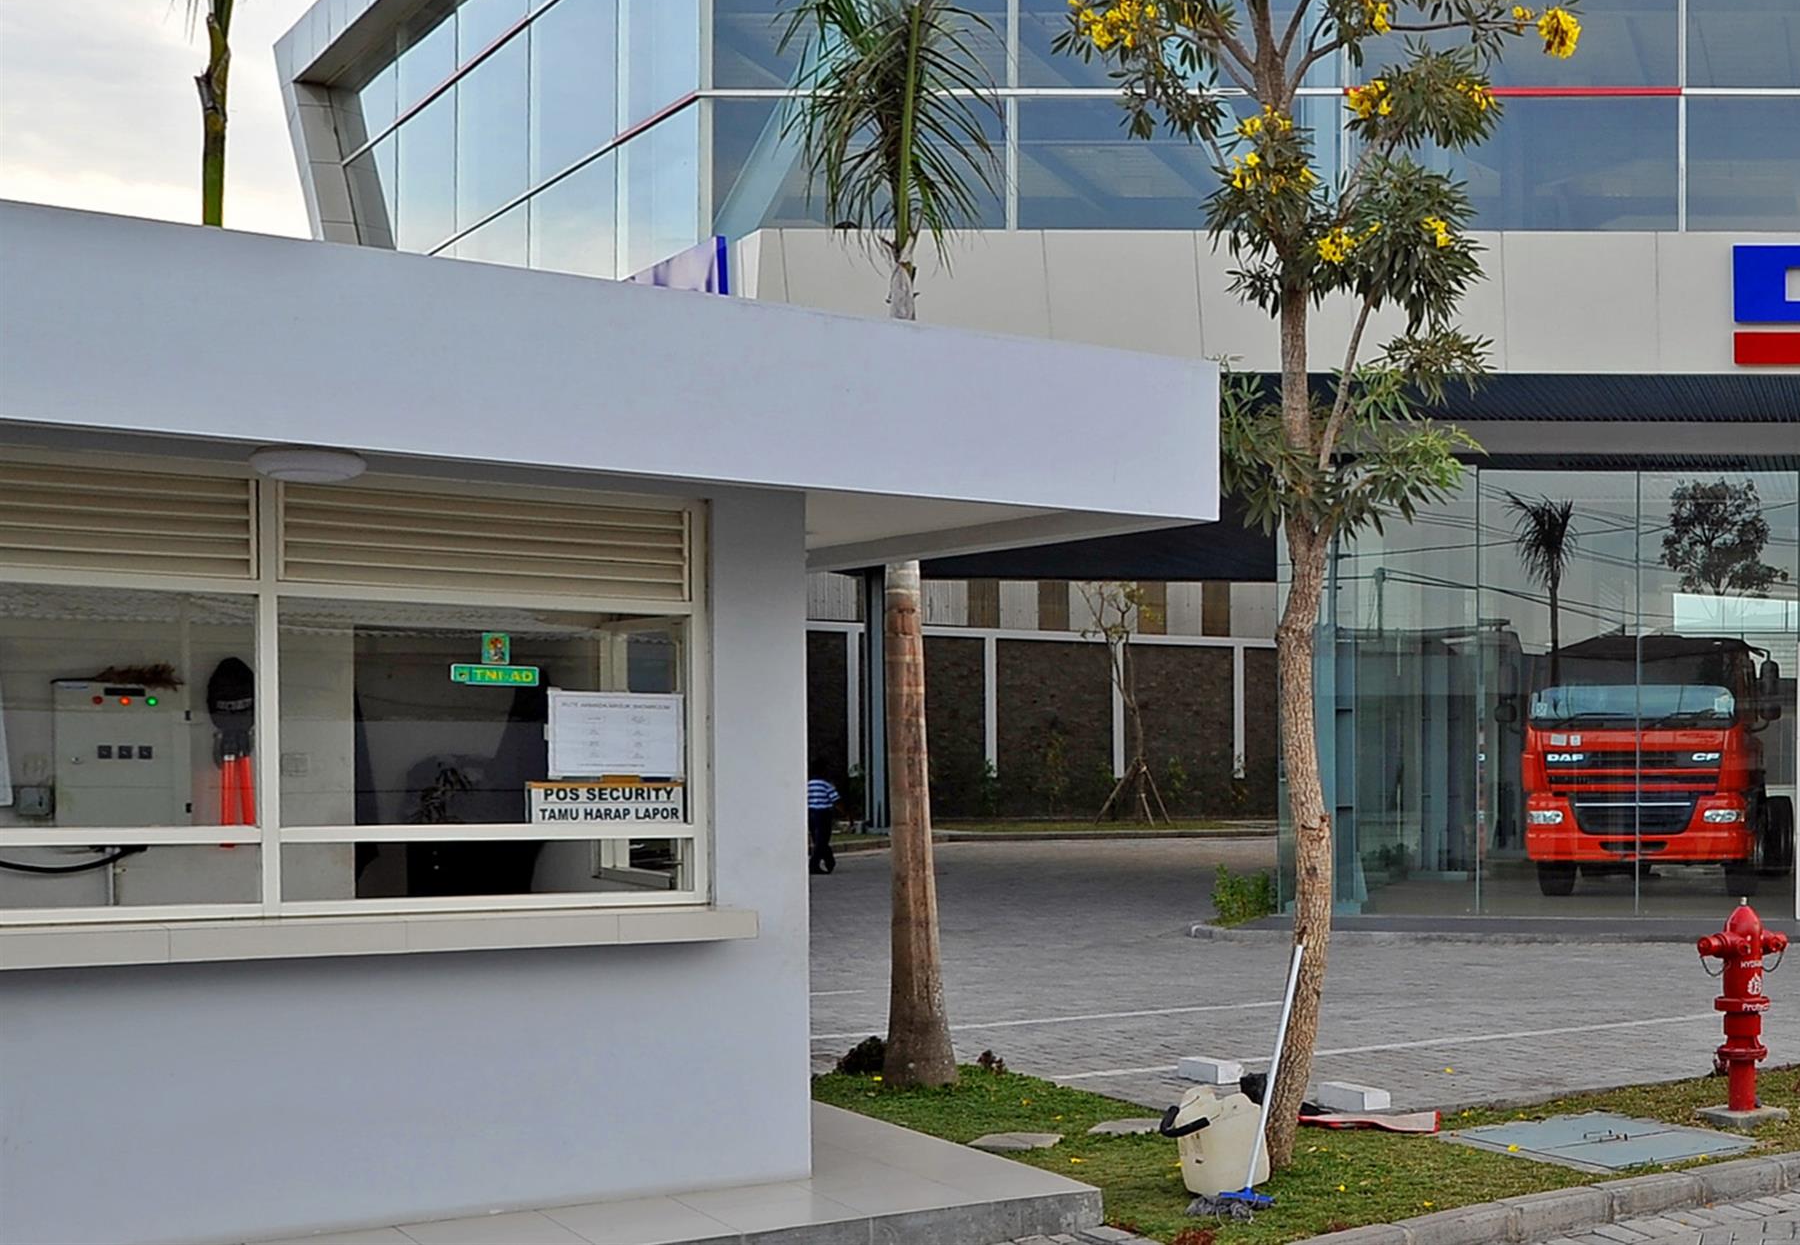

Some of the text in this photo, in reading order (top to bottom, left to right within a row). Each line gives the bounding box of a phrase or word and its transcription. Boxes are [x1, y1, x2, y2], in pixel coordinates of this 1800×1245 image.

[543, 787, 675, 801] POS SECURITY
[539, 807, 680, 821] TAMU HARAP LAPOR
